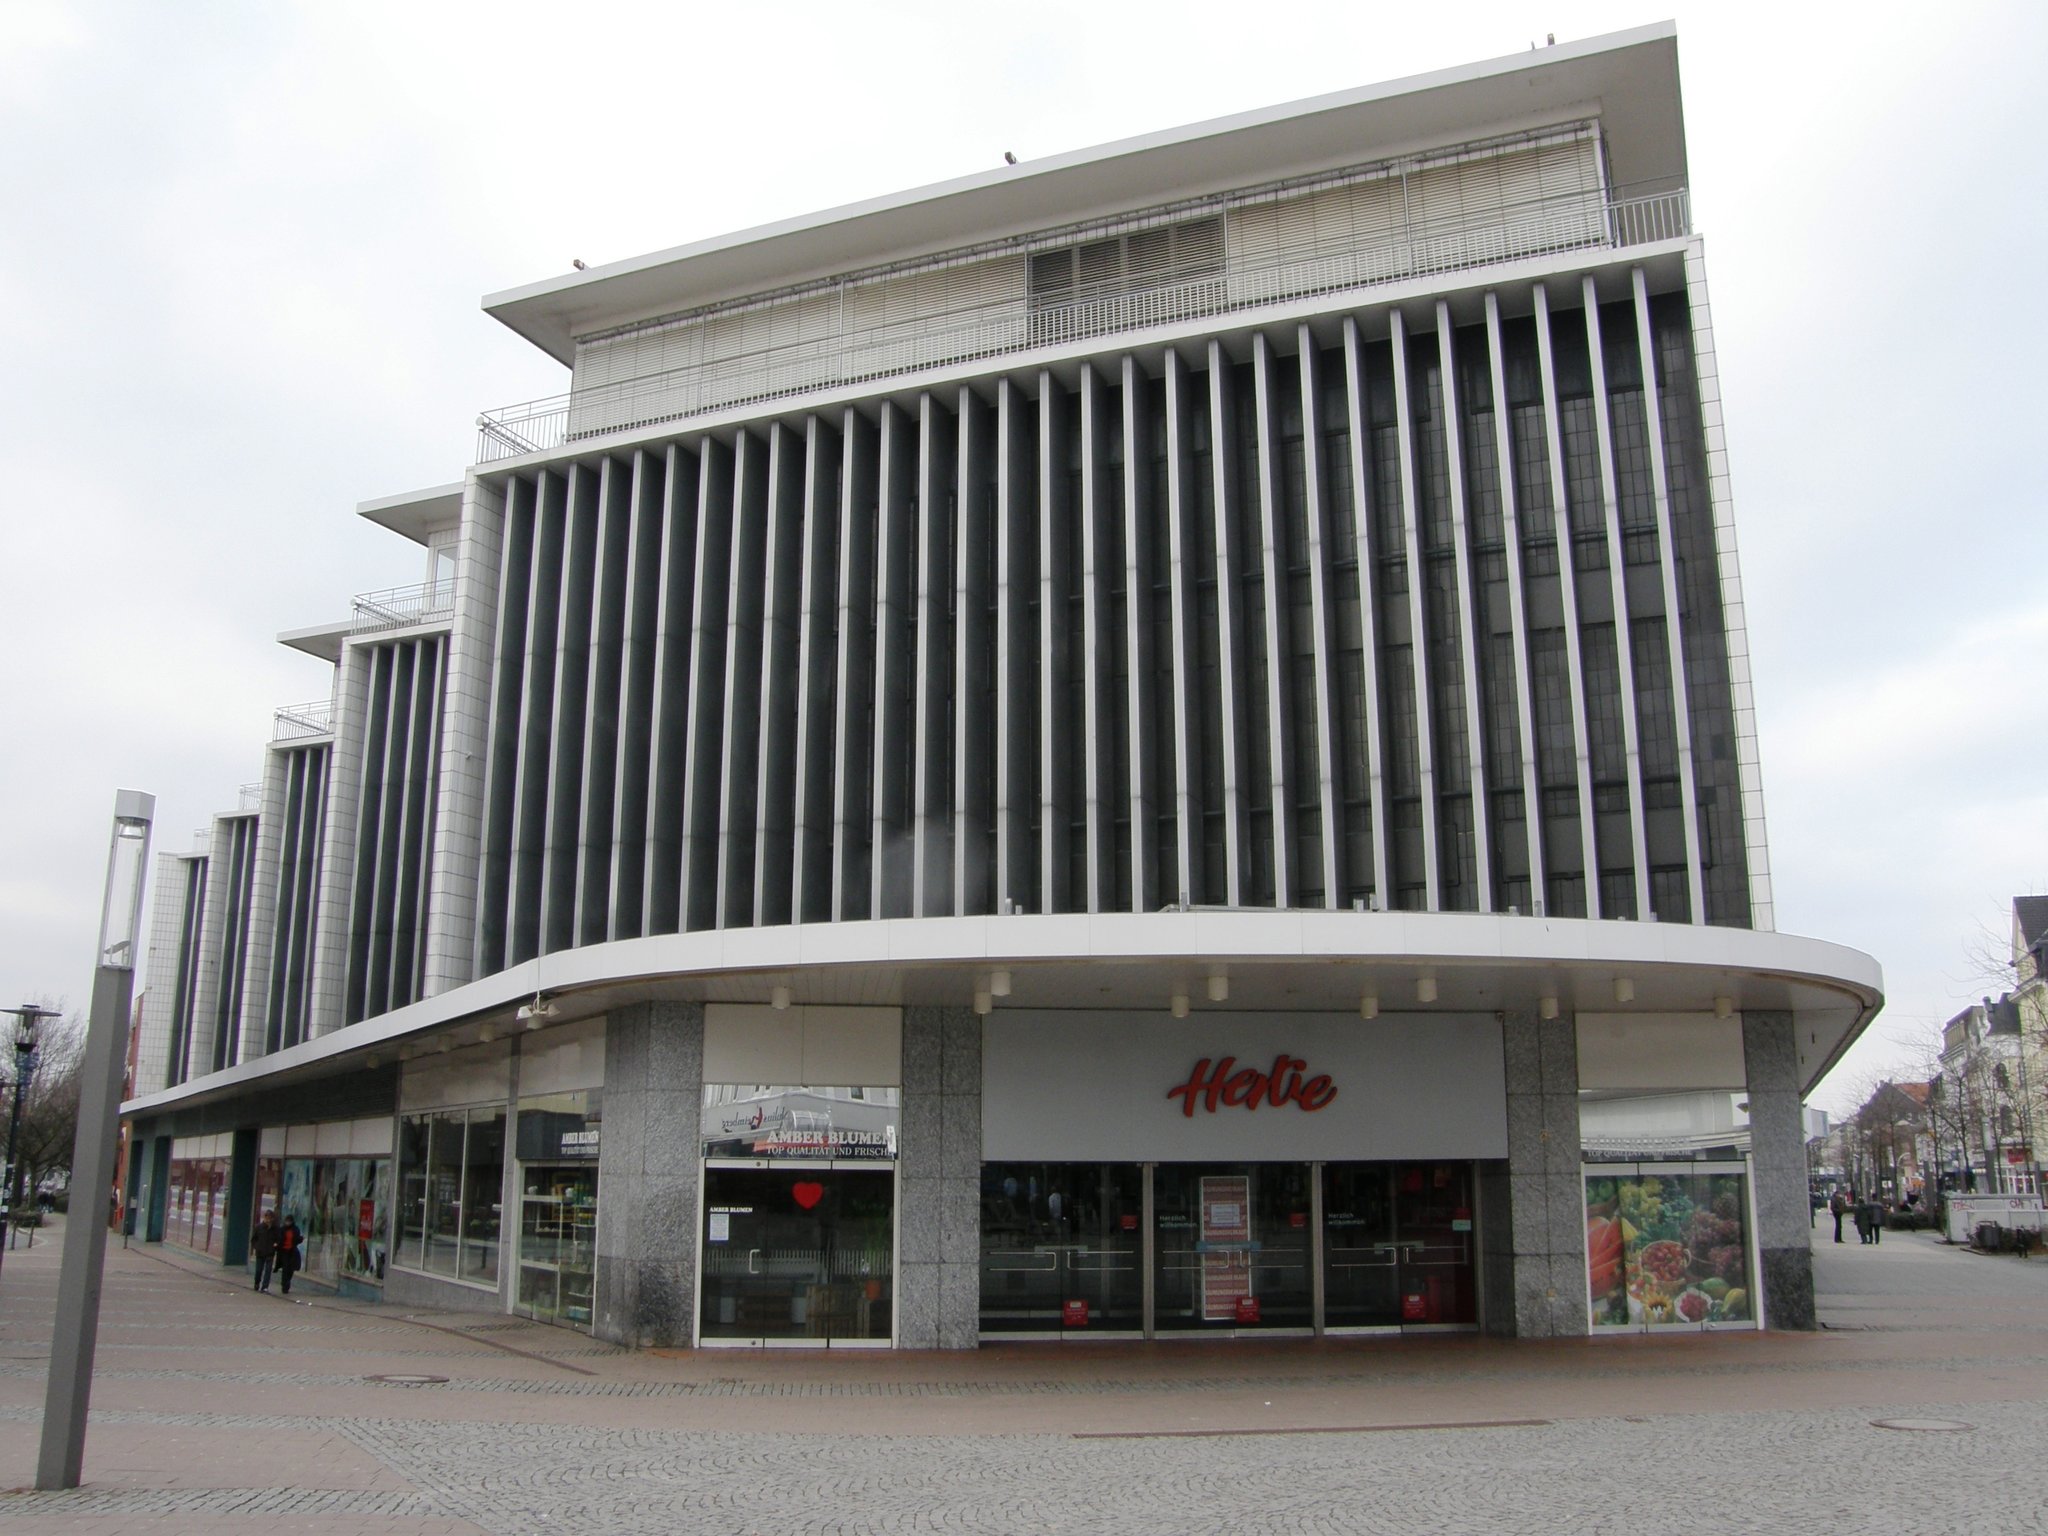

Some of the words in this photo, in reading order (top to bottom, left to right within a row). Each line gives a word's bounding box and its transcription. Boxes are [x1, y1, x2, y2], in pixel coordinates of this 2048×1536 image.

[1167, 1054, 1338, 1118] Hertie
[767, 1131, 823, 1144] AMBER
[766, 1146, 784, 1155] TOP
[832, 1147, 852, 1156] UND
